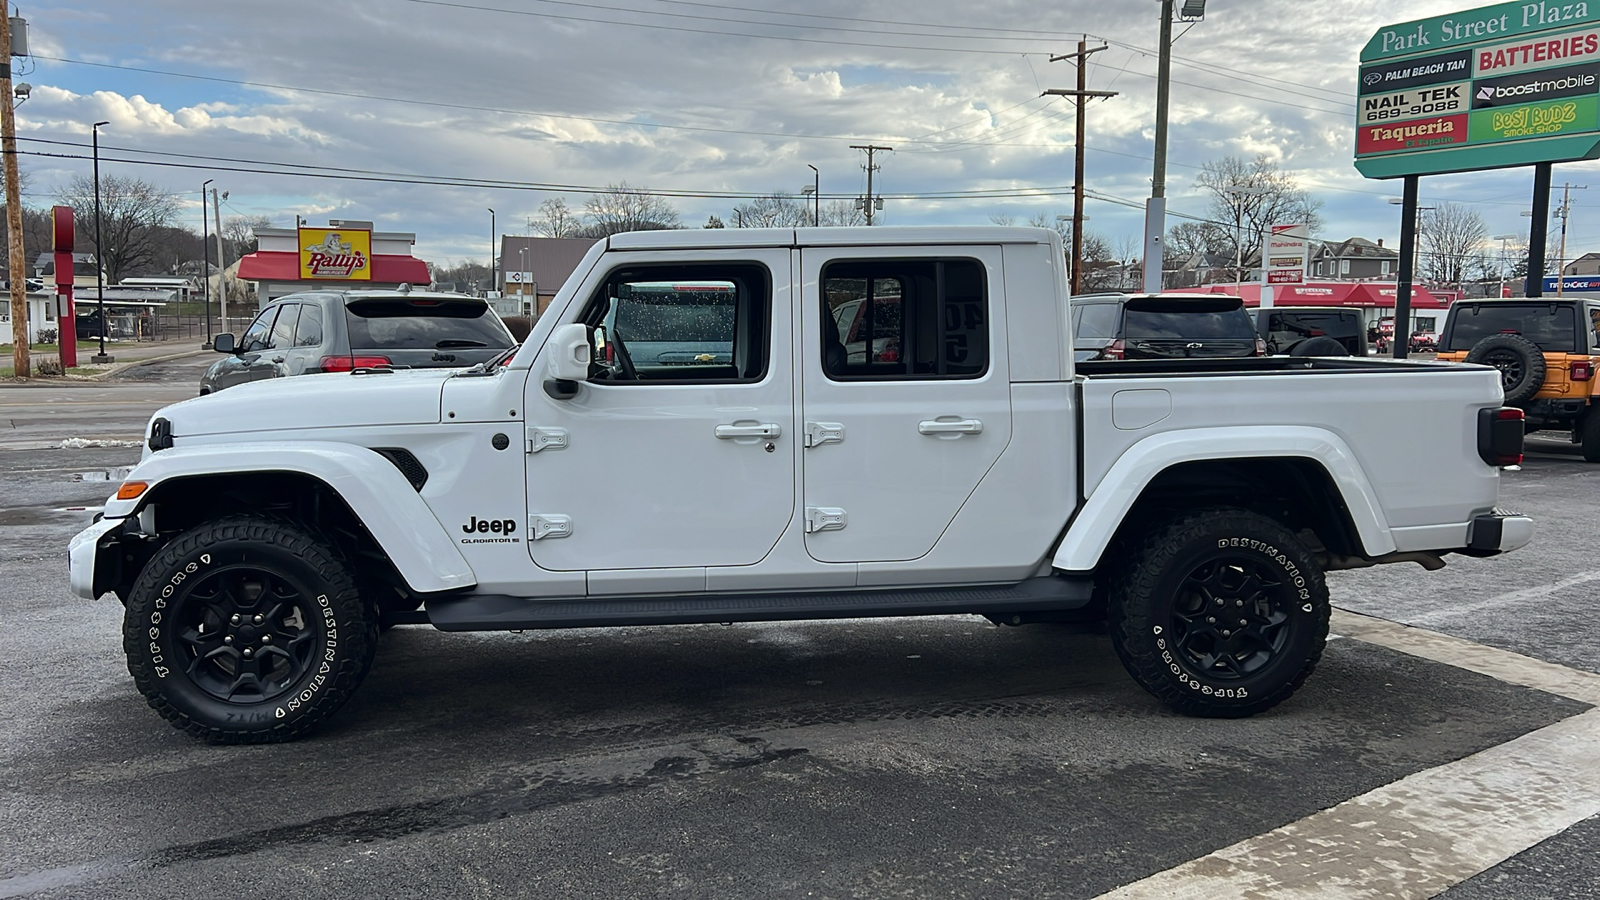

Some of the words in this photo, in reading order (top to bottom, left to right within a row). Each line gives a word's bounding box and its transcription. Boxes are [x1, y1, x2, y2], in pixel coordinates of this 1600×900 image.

[1382, 25, 1430, 53] Park
[1441, 13, 1508, 42] Street
[1521, 1, 1588, 27] Plaza
[1479, 34, 1598, 71] BATTERIES
[1385, 69, 1411, 81] PALM
[1412, 63, 1445, 77] BEACH
[1446, 59, 1466, 71] TAN
[1365, 95, 1409, 110] NAIL
[1418, 86, 1460, 102] TEK
[1367, 100, 1459, 121] 689-9088
[1503, 126, 1534, 138] SMOKE
[1536, 124, 1562, 134] SHOP
[307, 251, 366, 276] Rally's
[432, 353, 456, 362] Jeep
[462, 516, 516, 536] Jeep
[1218, 537, 1310, 600] DESTINATION
[287, 594, 338, 712] DESTINATION
